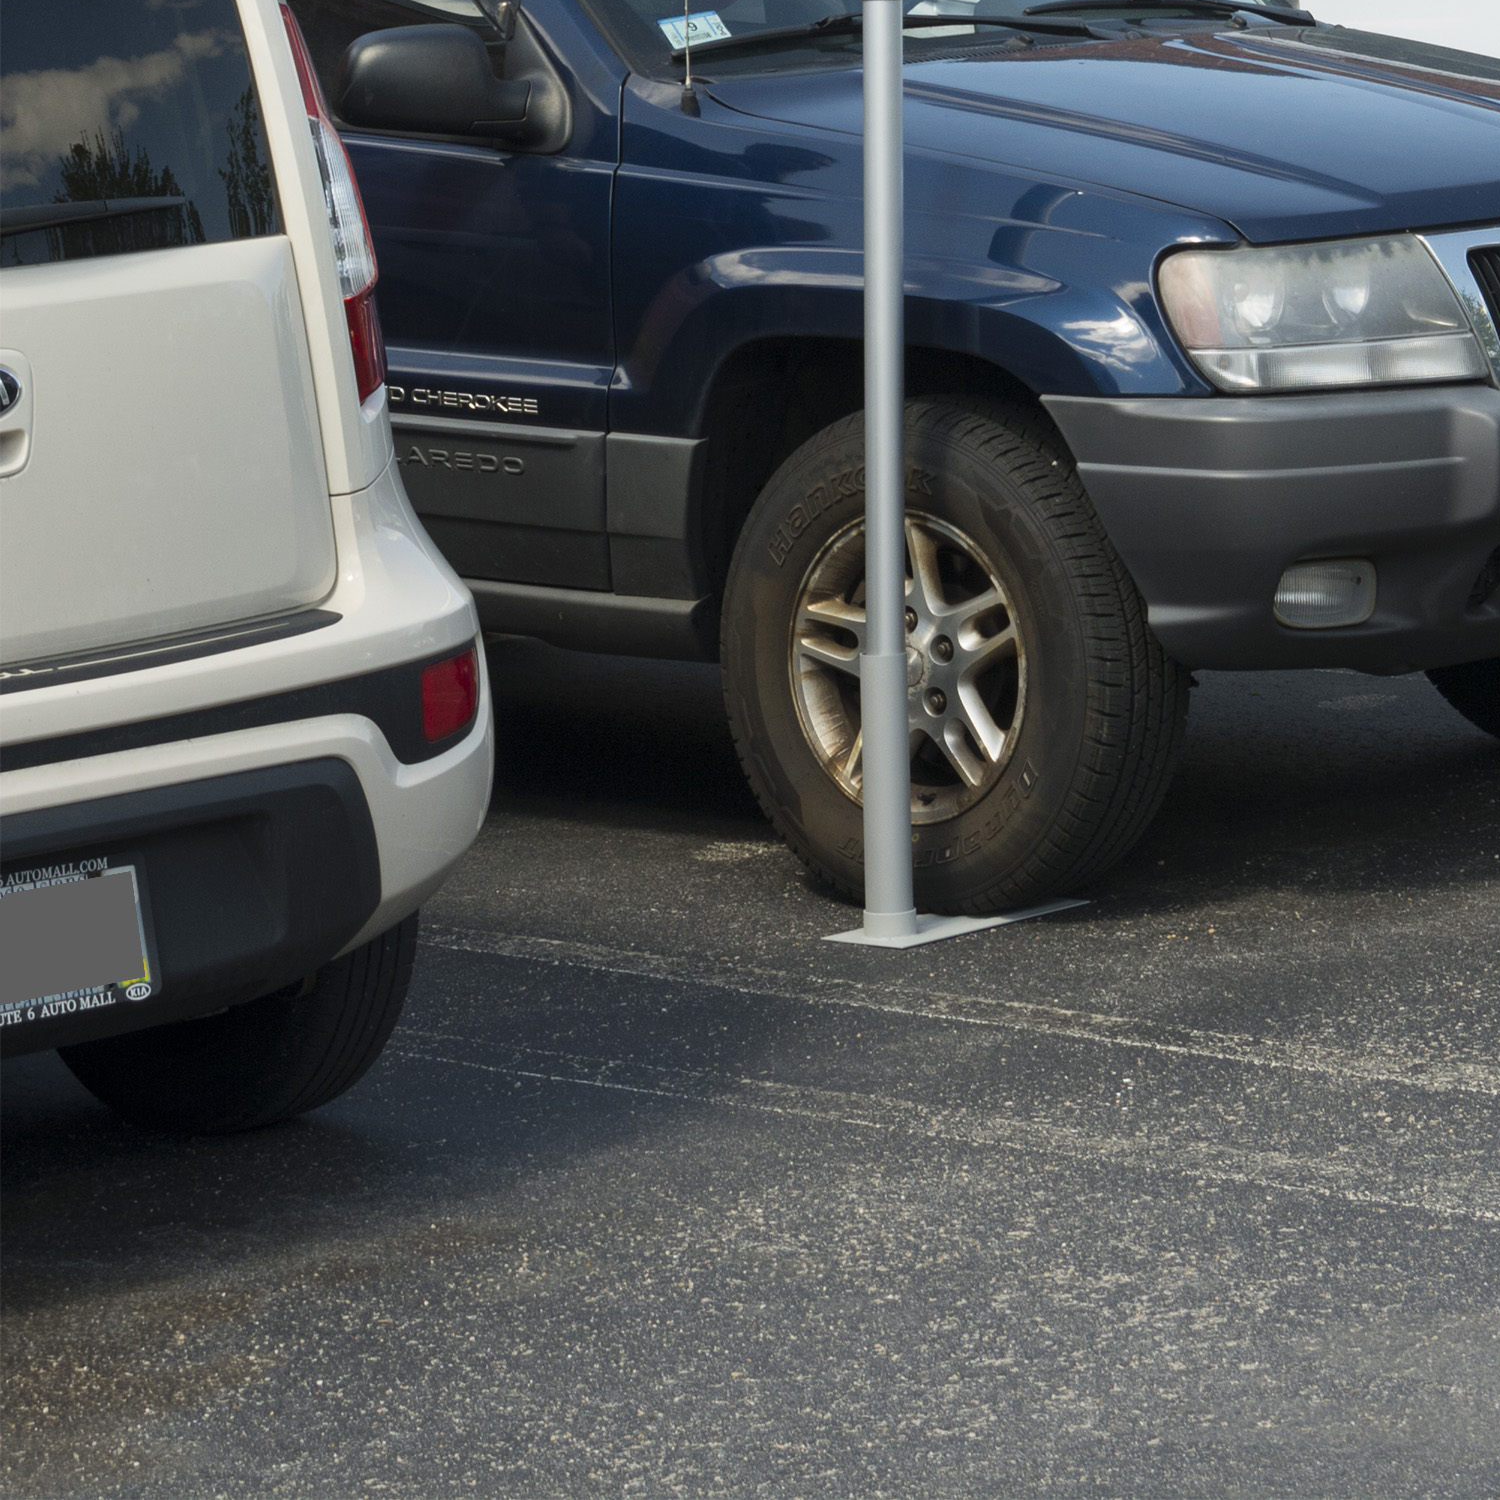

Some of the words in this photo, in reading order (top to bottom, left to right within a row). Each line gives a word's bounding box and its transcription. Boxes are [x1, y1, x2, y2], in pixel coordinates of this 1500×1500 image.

[411, 387, 539, 416] CHEROKEE
[767, 465, 937, 567] Hankok
[913, 756, 1040, 869] Dynapr
[6, 856, 109, 886] AUTOMALL.COM
[27, 1006, 36, 1021] 6
[40, 999, 78, 1019] AUTO
[79, 991, 116, 1011] MALL
[130, 984, 148, 998] KIA
